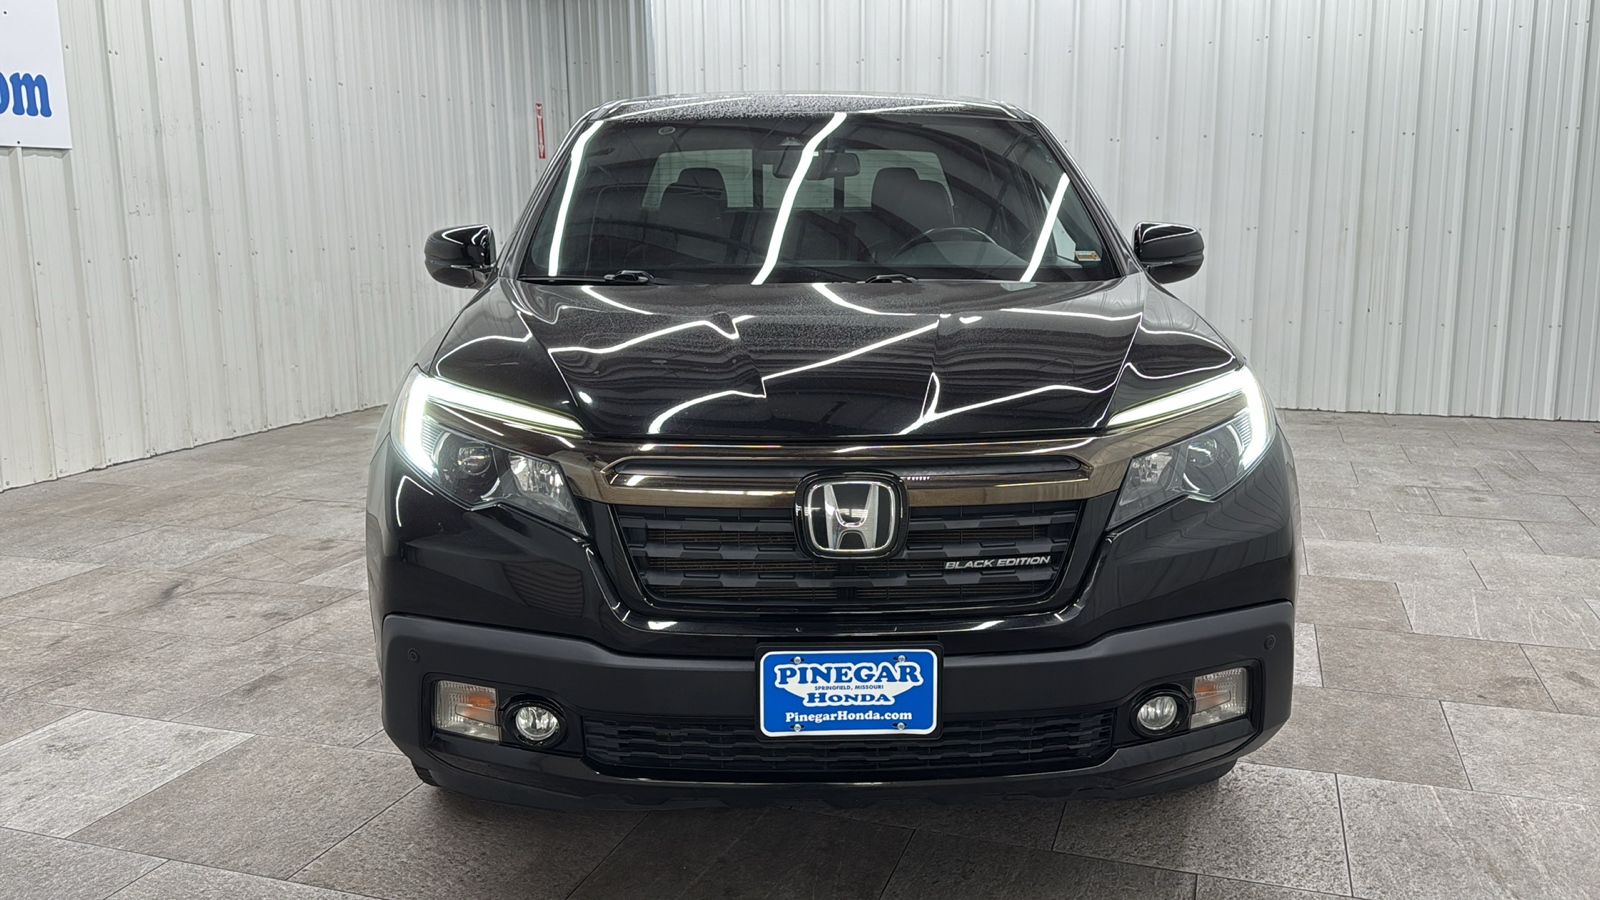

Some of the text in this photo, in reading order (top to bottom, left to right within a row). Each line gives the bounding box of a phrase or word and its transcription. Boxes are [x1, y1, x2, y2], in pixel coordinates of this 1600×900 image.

[945, 556, 1051, 570] BLACK EDITION
[778, 665, 920, 685] PINEGAR
[785, 710, 912, 724] PinegarHonda.com
